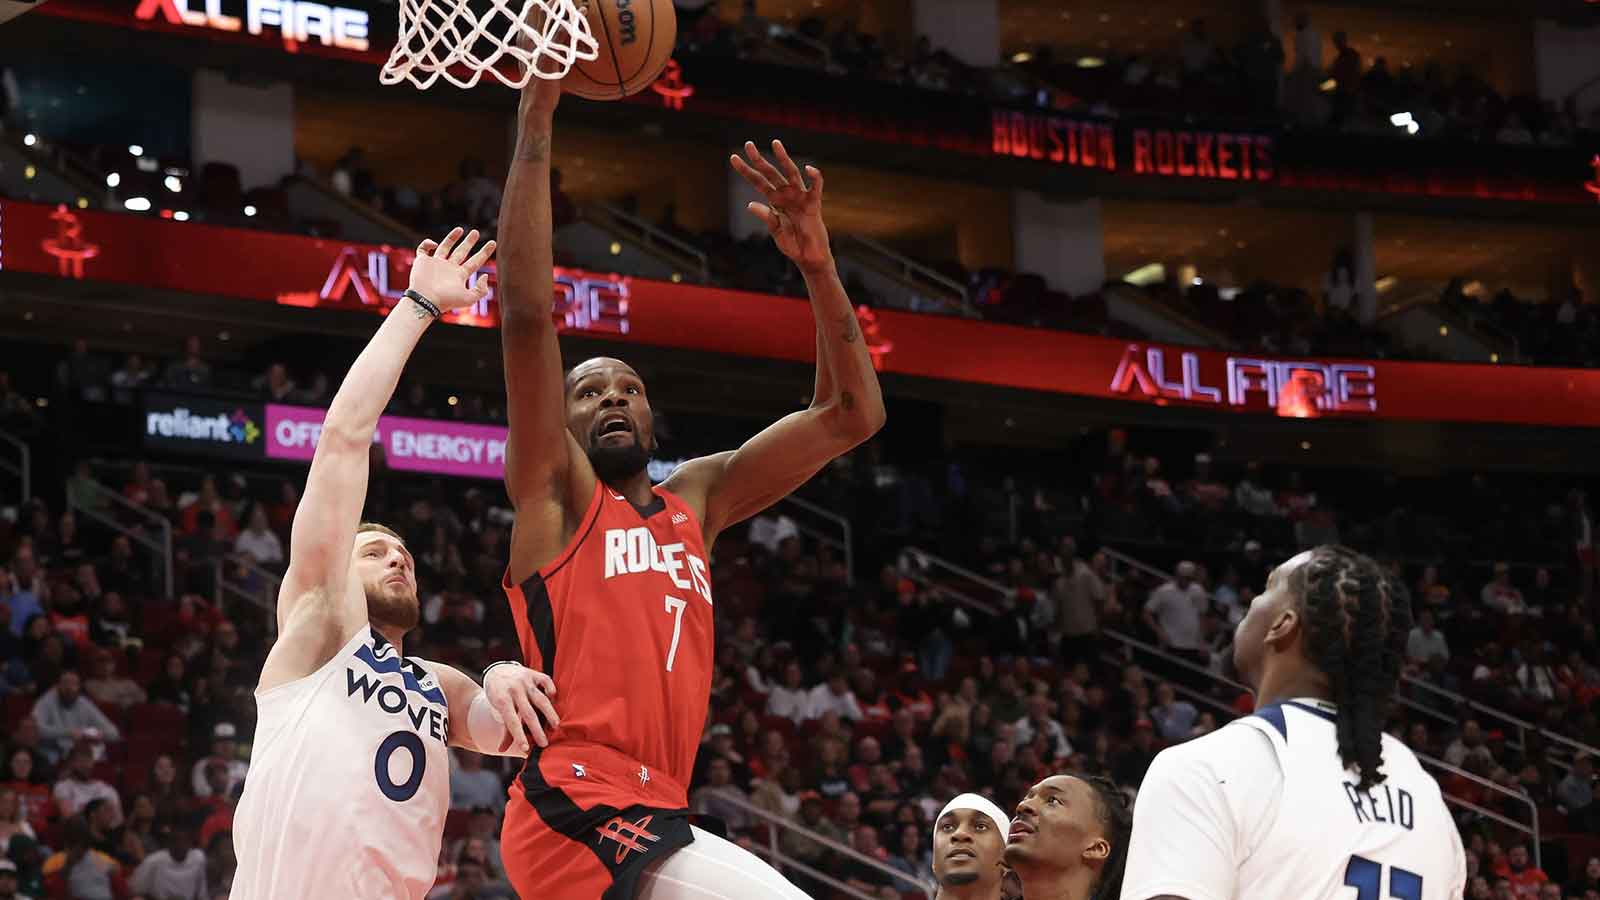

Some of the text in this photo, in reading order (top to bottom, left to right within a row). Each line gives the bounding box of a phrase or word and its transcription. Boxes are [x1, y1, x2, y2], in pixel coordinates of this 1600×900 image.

[247, 0, 370, 51] FIRE
[992, 110, 1274, 181] HOUSTON ROCKETS
[1110, 343, 1377, 413] ALL FIRE
[146, 407, 232, 443] reliant
[391, 430, 483, 464] ENERGY
[664, 594, 688, 673] 7
[374, 730, 427, 803] 0
[1342, 780, 1414, 831] REID
